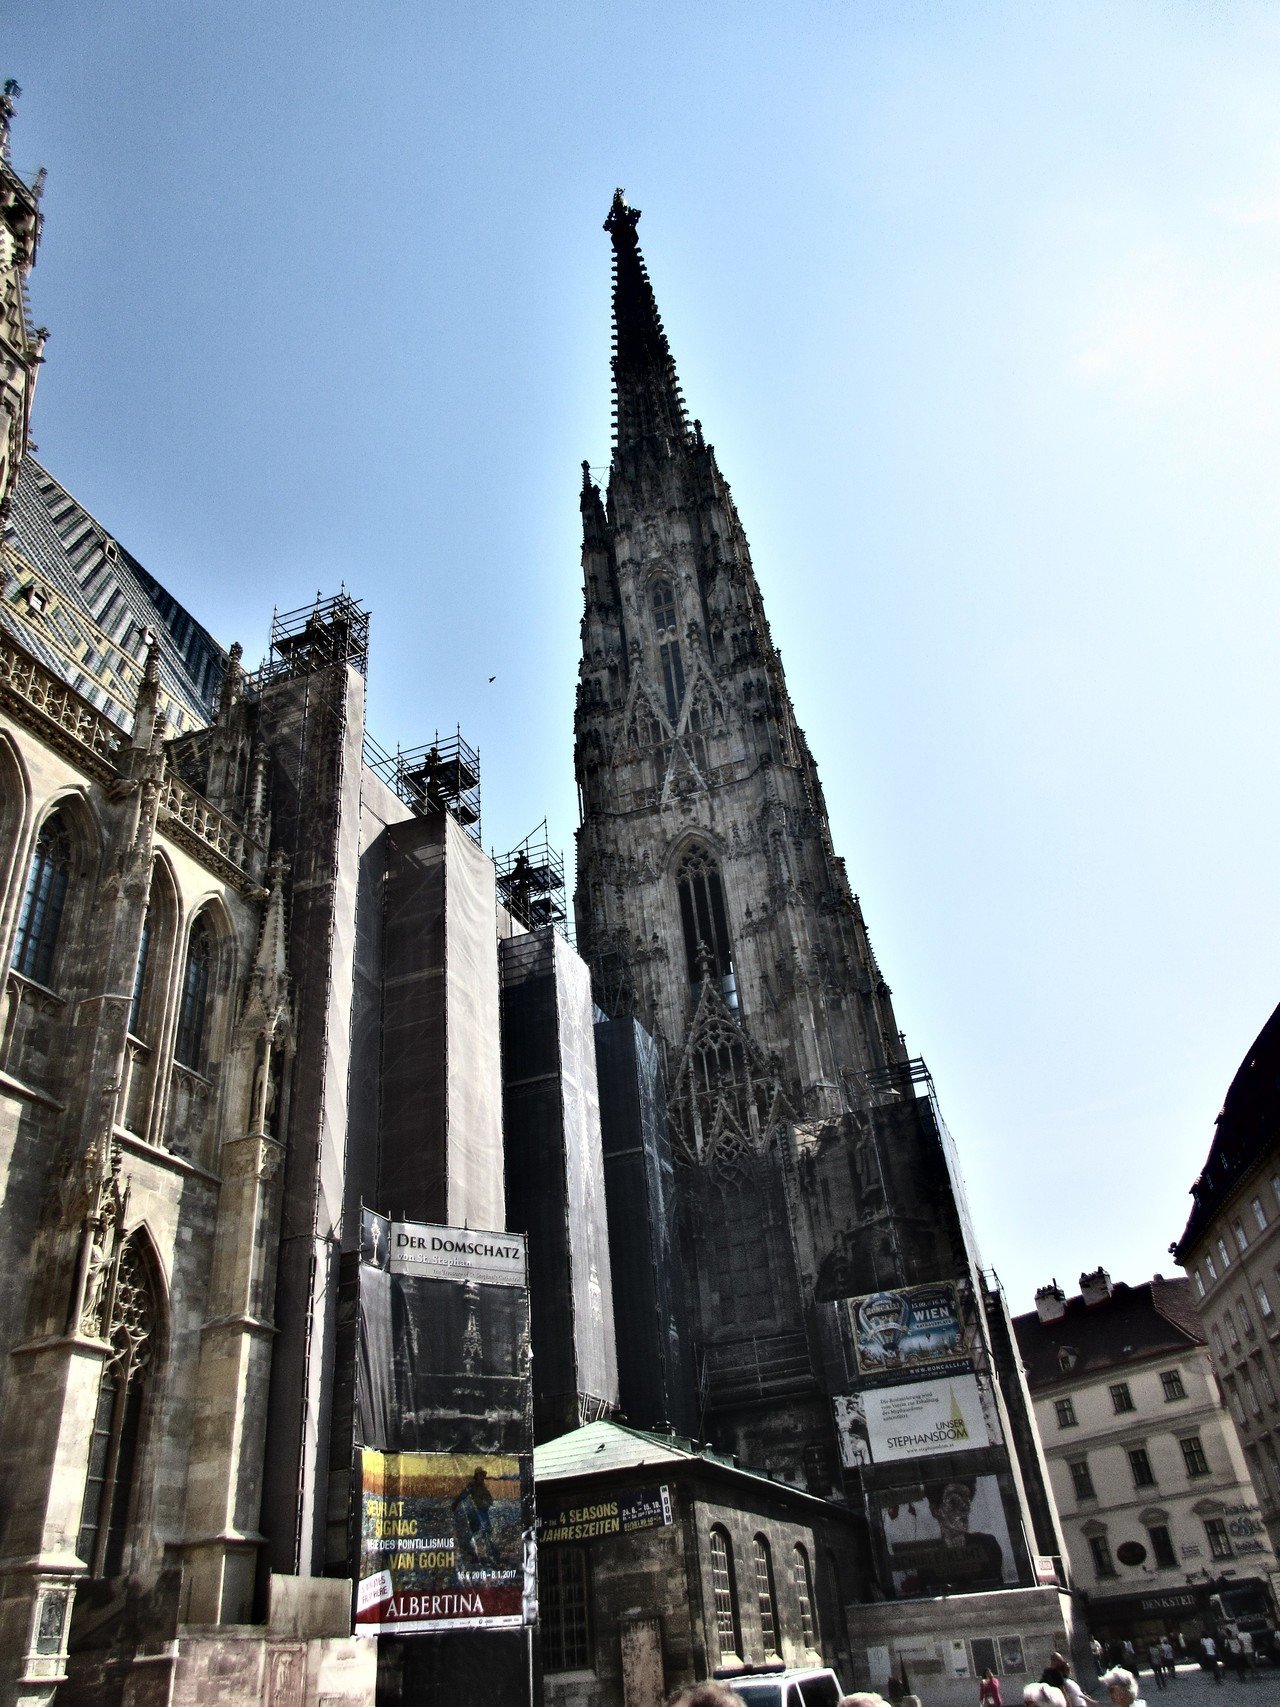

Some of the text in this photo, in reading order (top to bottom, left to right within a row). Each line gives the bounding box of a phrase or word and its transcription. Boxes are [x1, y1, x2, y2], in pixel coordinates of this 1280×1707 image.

[397, 1233, 520, 1260] DER DOMSCHATZ
[417, 1254, 430, 1263] St.
[913, 1306, 949, 1321] WIEN
[936, 1419, 964, 1430] UNSER
[887, 1428, 969, 1449] STEPHANSDOM
[560, 1512, 566, 1525] 4
[569, 1501, 618, 1523] SEASONS
[540, 1517, 620, 1543] JAHRESZEITEN
[397, 1537, 455, 1550] POINTILLISMUS
[390, 1551, 455, 1570] VAN GOGH
[386, 1593, 484, 1617] ALBERTINA
